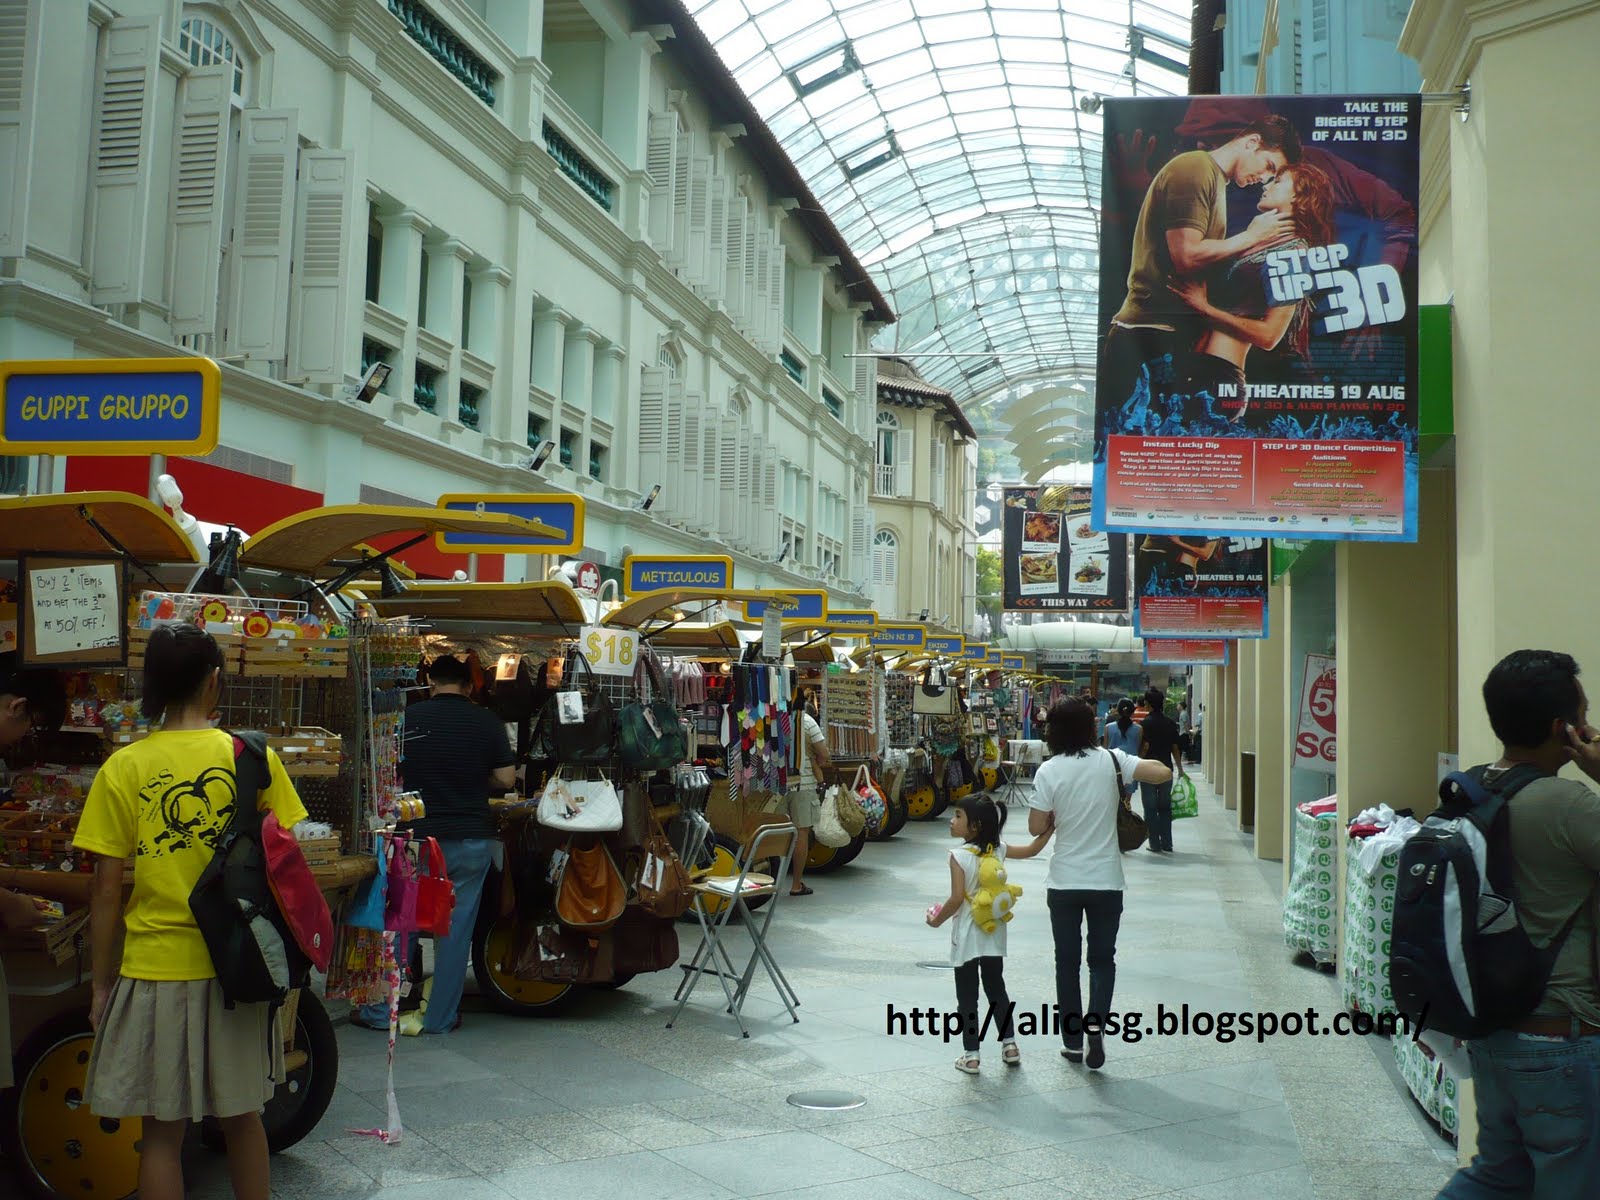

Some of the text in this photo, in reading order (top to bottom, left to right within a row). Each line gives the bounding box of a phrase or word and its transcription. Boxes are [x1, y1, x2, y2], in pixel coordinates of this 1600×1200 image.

[1344, 102, 1408, 113] TAKE THE
[1315, 116, 1408, 127] BIGGEST STEP
[1312, 130, 1408, 141] OF ALL IN 3D
[1270, 264, 1406, 333] UP 3D
[1218, 384, 1405, 400] IN THEATRES 19 AUG
[21, 394, 189, 421] GUPPI GRUPPO
[1298, 402, 1323, 410] ALSO
[1327, 402, 1369, 410] PLAYING
[1373, 402, 1384, 410] IN
[1178, 441, 1203, 449] Lucky
[1343, 445, 1397, 453] Competition
[640, 571, 720, 583] METICULOUS
[62, 575, 70, 592] 2
[37, 599, 52, 608] AND
[54, 599, 68, 609] GET
[73, 598, 88, 607] THE
[1040, 599, 1089, 607] THIS WAY
[44, 621, 52, 630] AT
[56, 616, 79, 634] 50%
[82, 617, 98, 630] OFF
[586, 632, 633, 666] $18
[1311, 689, 1336, 717] 5
